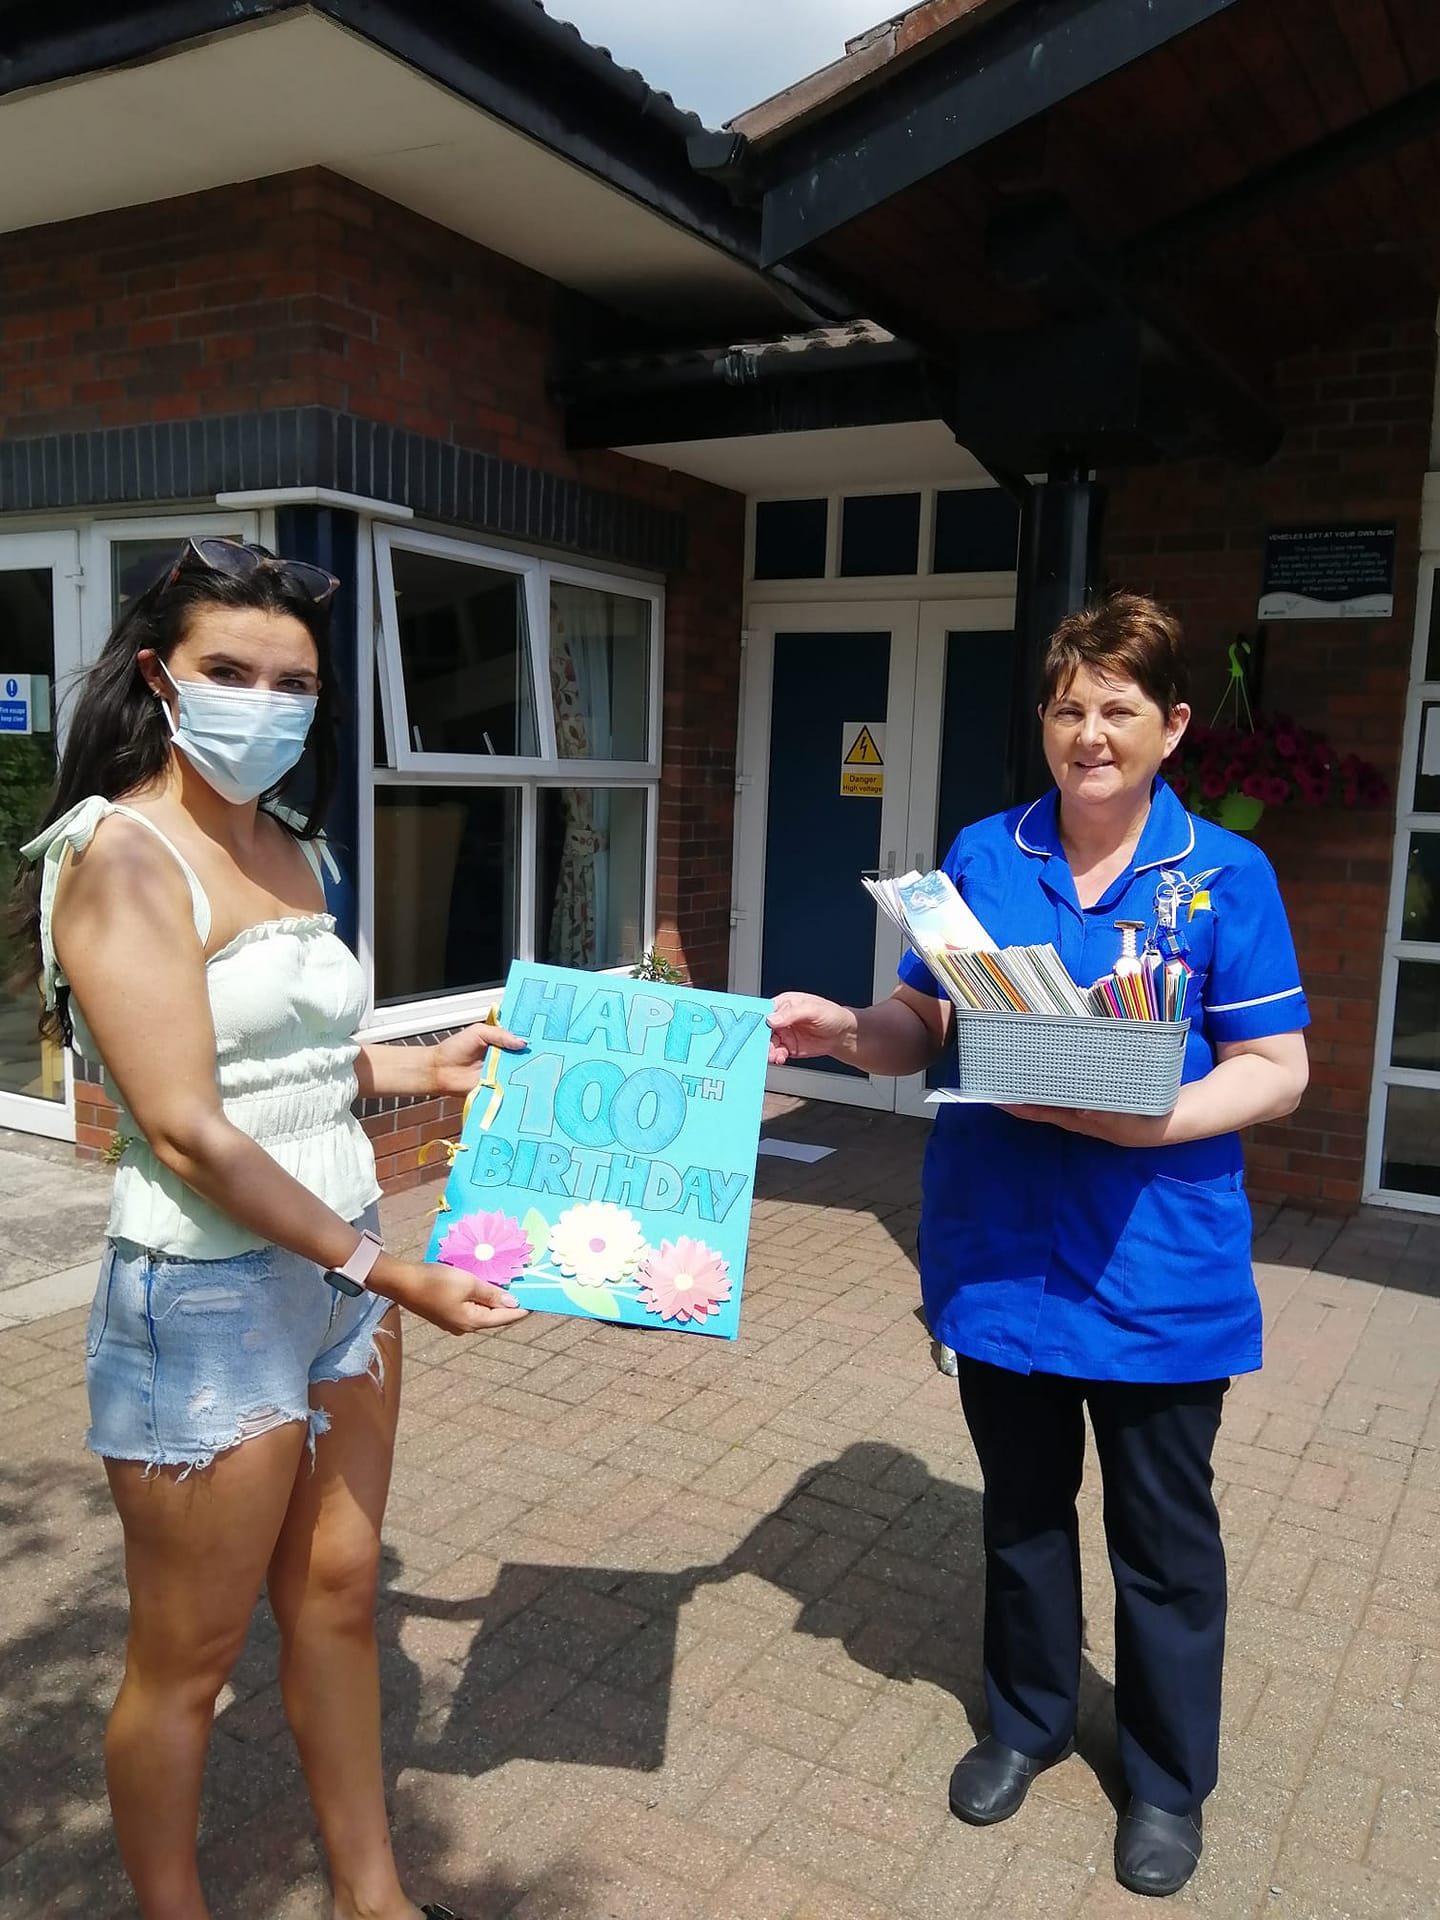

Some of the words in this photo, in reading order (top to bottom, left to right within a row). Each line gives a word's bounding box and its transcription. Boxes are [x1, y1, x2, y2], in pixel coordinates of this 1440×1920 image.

[1268, 533, 1304, 541] VEHICLES
[849, 775, 876, 784] Danger
[843, 784, 858, 792] High
[508, 977, 765, 1070] HAPPY
[469, 1134, 749, 1224] BIRTHDAY
